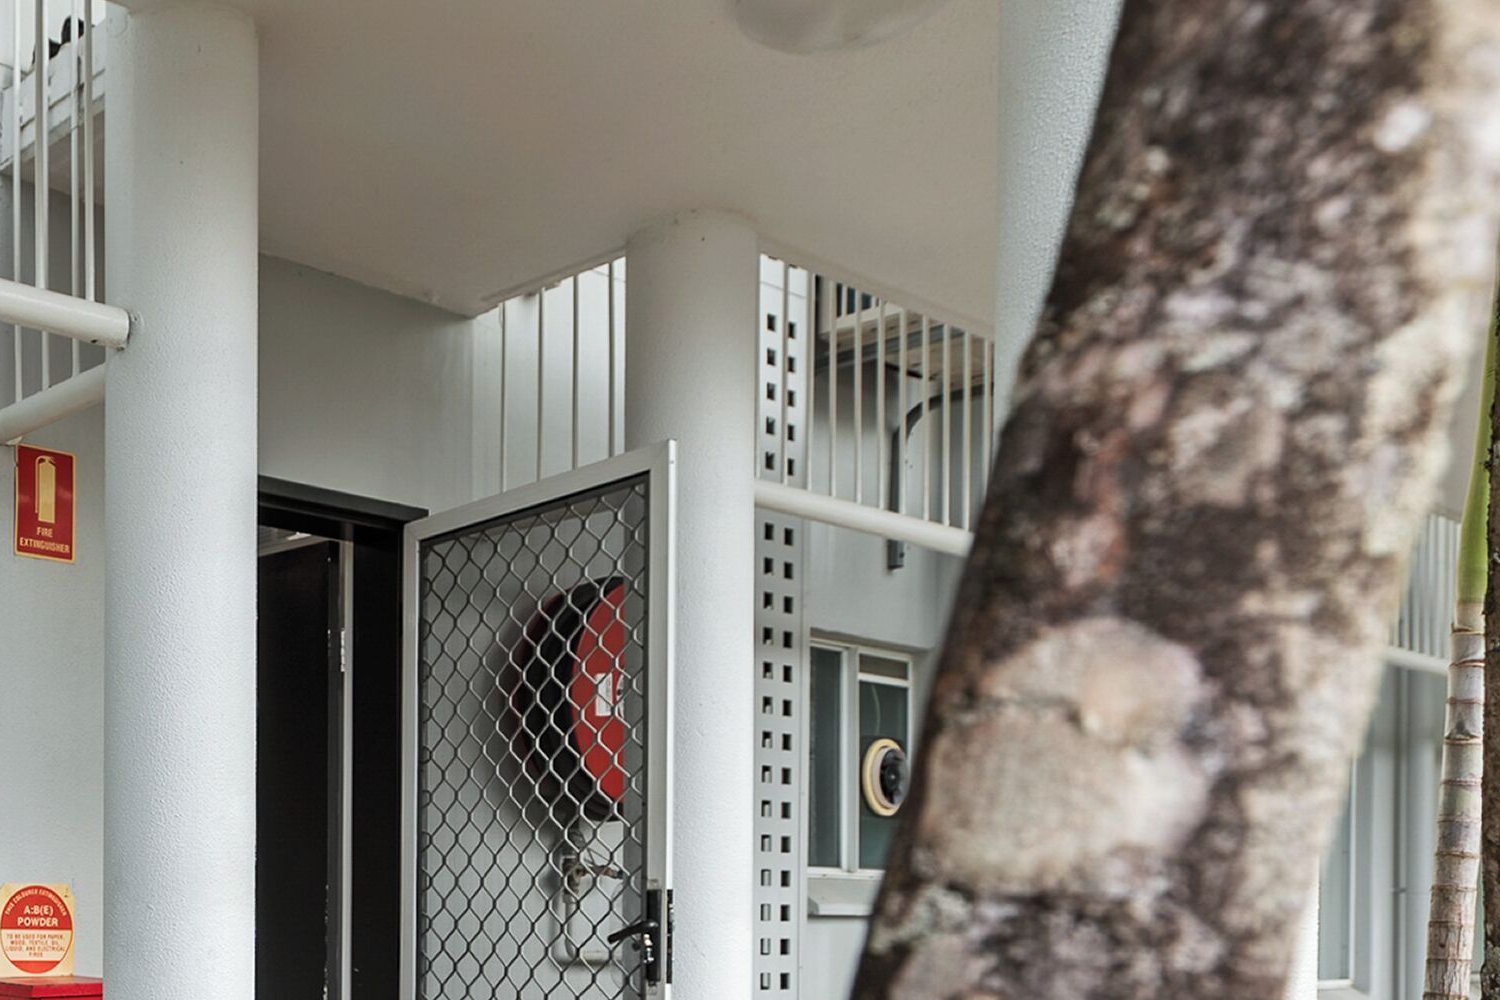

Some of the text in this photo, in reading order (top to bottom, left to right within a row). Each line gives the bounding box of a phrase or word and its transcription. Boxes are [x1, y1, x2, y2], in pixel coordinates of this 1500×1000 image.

[36, 527, 53, 538] FIRE
[19, 537, 70, 553] EXTINGUISHER
[17, 916, 59, 927] POWDER
